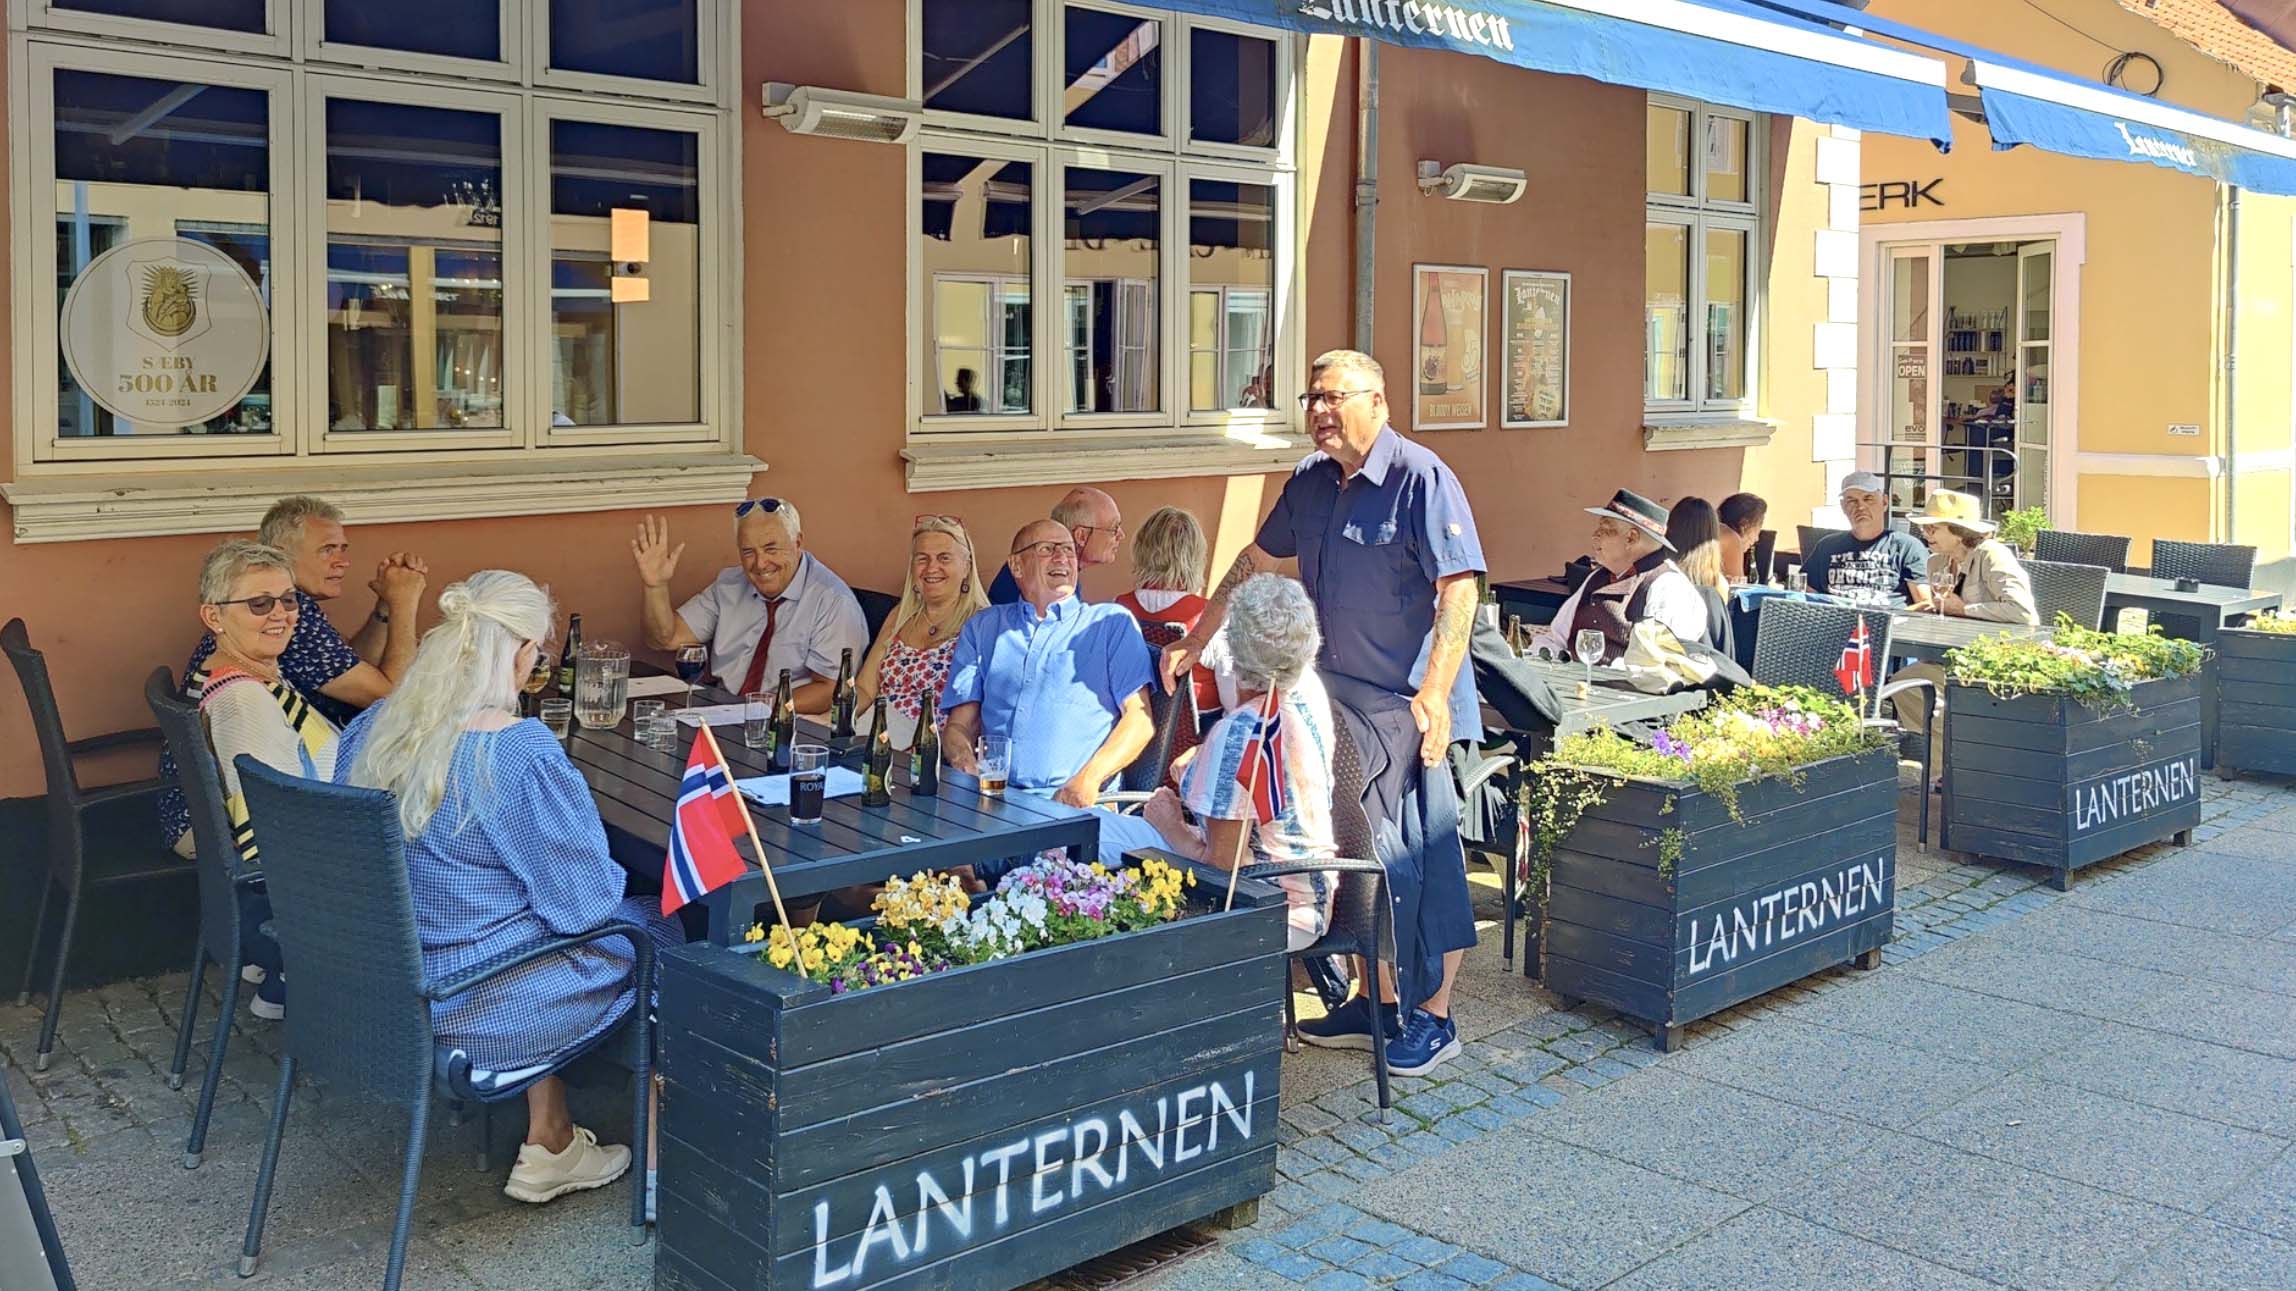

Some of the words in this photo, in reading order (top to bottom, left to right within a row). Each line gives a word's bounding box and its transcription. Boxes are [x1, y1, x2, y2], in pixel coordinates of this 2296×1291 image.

[118, 374, 174, 393] 500
[178, 368, 218, 393] ÅR
[1898, 364, 1926, 377] OPEN
[2075, 757, 2195, 831] LANTERNEN
[1689, 856, 1884, 975] LANTERNEN
[812, 1070, 1256, 1289] LANTERNEN
